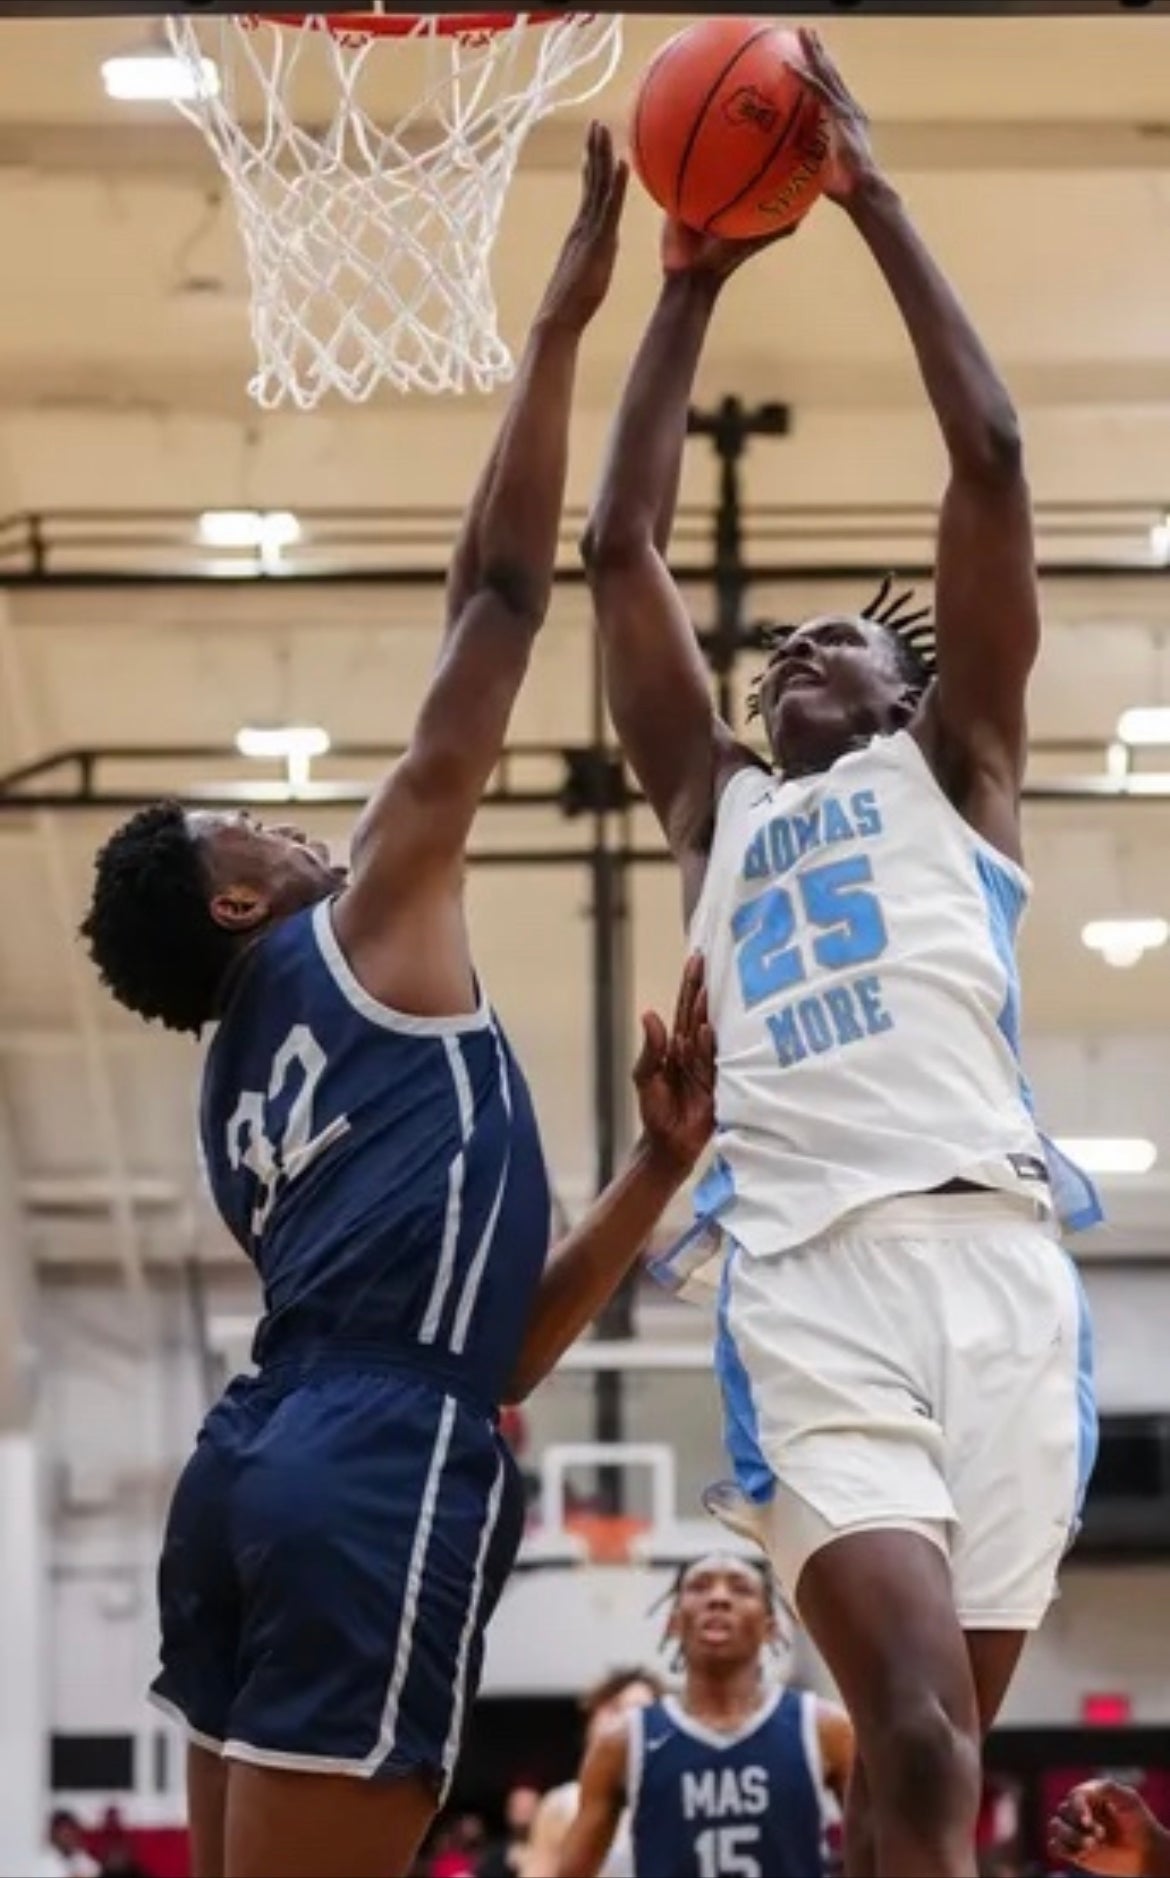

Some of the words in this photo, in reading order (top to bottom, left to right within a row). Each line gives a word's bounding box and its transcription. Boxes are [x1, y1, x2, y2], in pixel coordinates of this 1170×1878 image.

[730, 854, 888, 1009] 25
[765, 976, 894, 1068] MORE
[681, 1764, 770, 1820] MAS
[694, 1825, 762, 1878] 15
